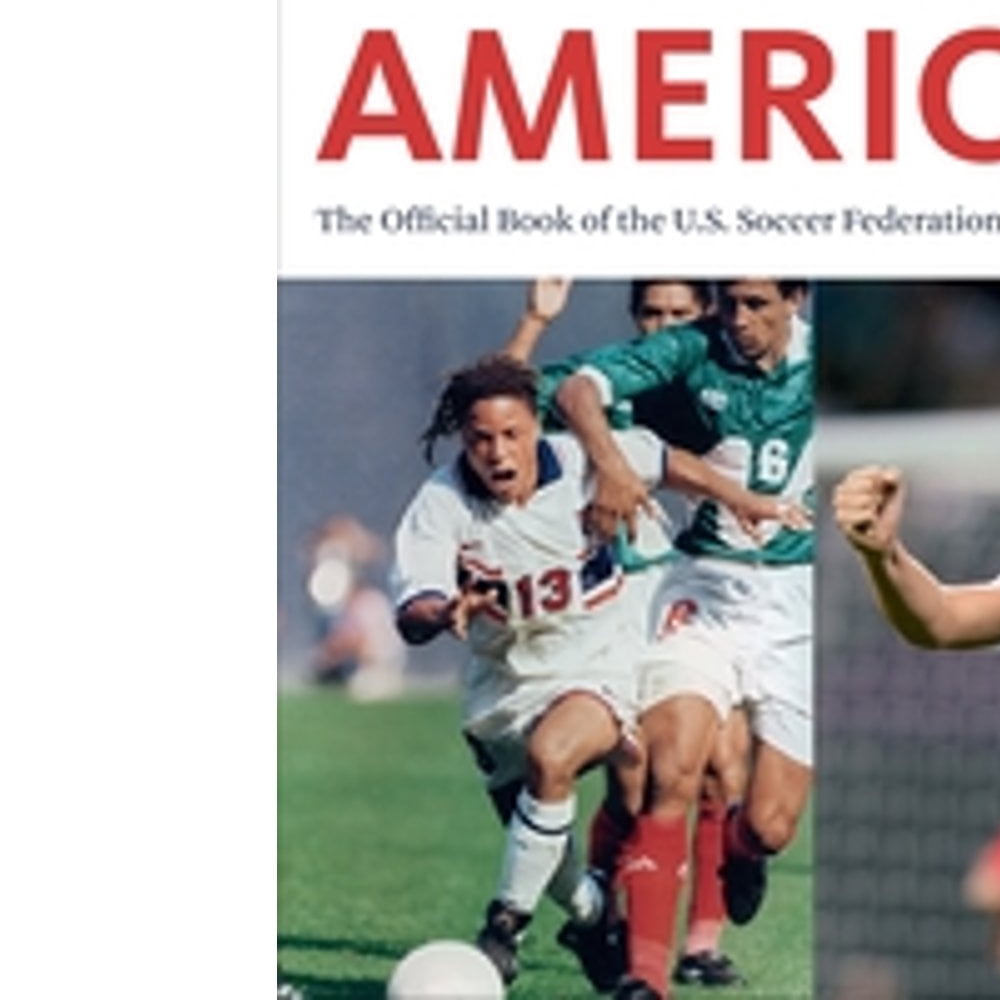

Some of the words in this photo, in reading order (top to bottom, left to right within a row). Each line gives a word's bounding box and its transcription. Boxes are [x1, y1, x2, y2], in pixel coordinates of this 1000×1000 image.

[315, 205, 373, 234] The
[380, 205, 489, 234] Official
[497, 205, 573, 234] Book
[580, 205, 613, 234] of
[617, 205, 667, 234] the
[673, 208, 729, 234] U.S.
[737, 208, 836, 234] Soccer
[516, 566, 573, 620] 13
